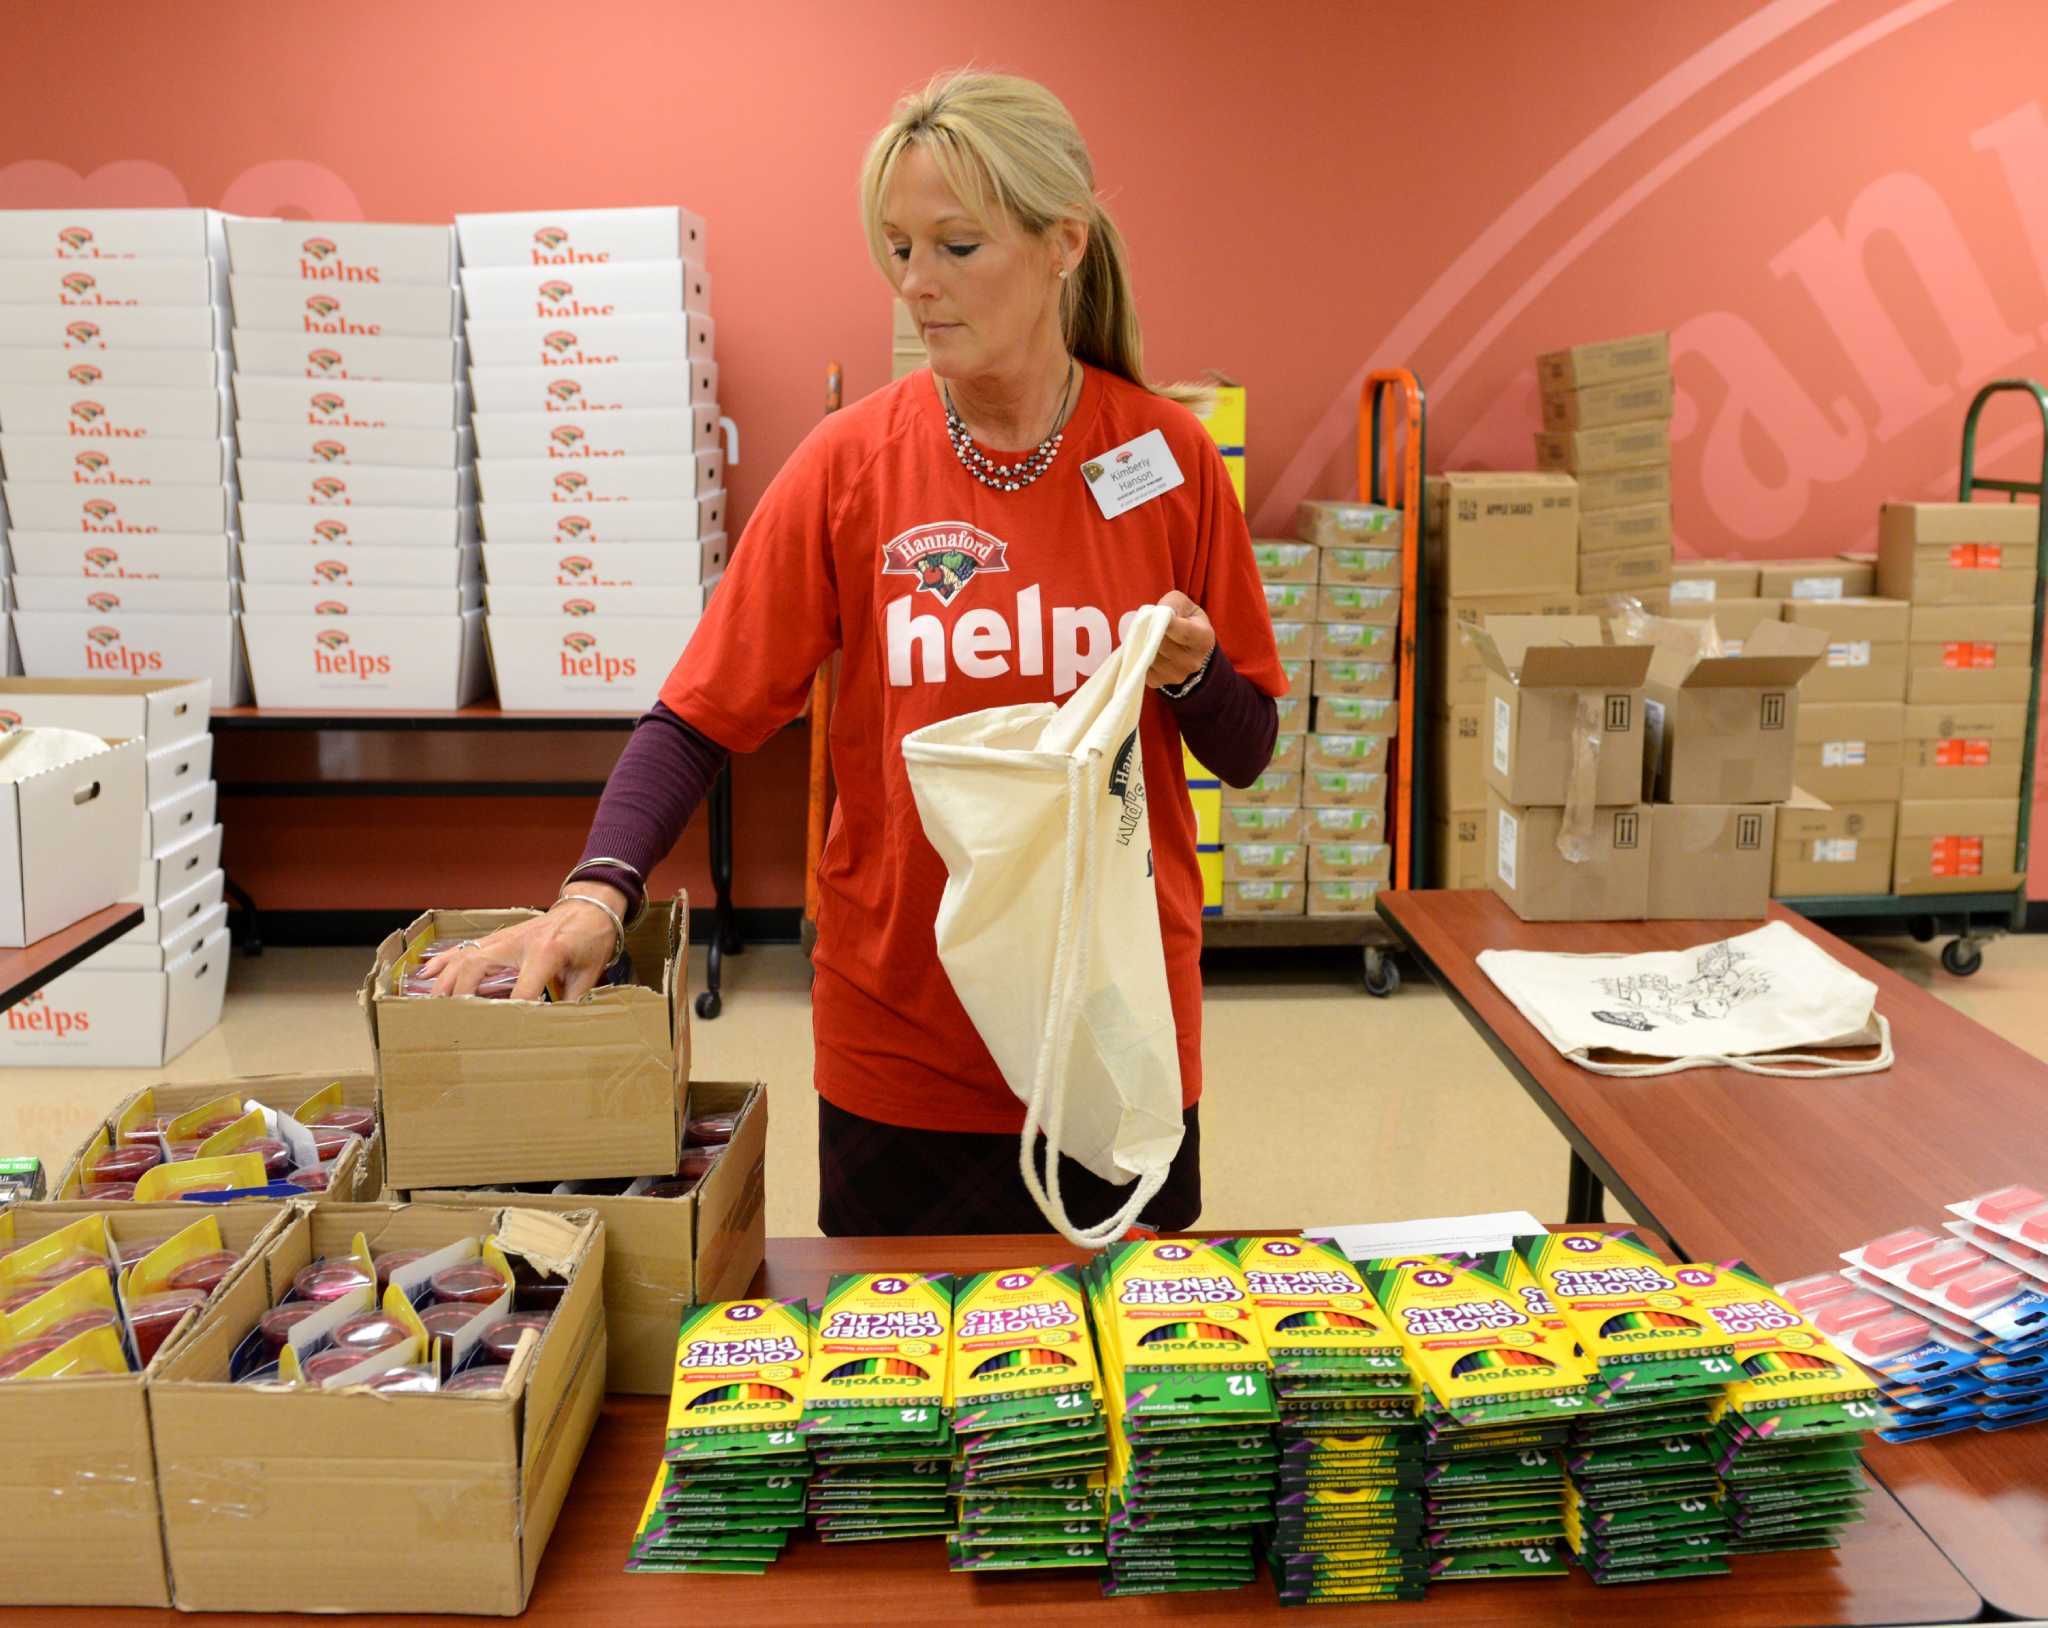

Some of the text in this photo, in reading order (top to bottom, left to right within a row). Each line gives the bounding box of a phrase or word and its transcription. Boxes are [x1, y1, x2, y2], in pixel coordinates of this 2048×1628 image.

[1111, 457, 1151, 482] Kimberly
[1119, 470, 1154, 492] Hanson
[899, 530, 996, 560] Hannaford
[887, 584, 1141, 696] help
[86, 646, 162, 675] helps
[314, 650, 391, 679] helps
[561, 652, 636, 681] helps
[8, 1006, 89, 1037] helps
[1268, 1243, 1295, 1254] 12
[1567, 1240, 1597, 1251] 12
[1160, 1248, 1186, 1258] 12
[1002, 1276, 1028, 1288] 12
[1244, 1271, 1350, 1283] PENCILS
[1419, 1272, 1447, 1284] 12
[1551, 1267, 1665, 1285] PENCILS
[1681, 1271, 1710, 1282] 12
[878, 1281, 902, 1291] 12
[1124, 1277, 1232, 1292] PENCILS
[1247, 1283, 1362, 1294] COLORED
[1555, 1280, 1677, 1297] COLORED
[1120, 1290, 1244, 1304] COLORED
[731, 1307, 757, 1318] 12
[964, 1301, 1070, 1324] PENCILS
[1402, 1300, 1515, 1323] PENCILS
[832, 1312, 936, 1326] PENCILS
[957, 1313, 1078, 1337] COLORED
[1407, 1313, 1529, 1334] COLORED
[821, 1326, 943, 1338] COLORED
[1287, 1328, 1375, 1338] Crayola
[1610, 1329, 1702, 1343] Crayola
[689, 1337, 795, 1355] PENCILS
[1148, 1341, 1242, 1353] Crayola
[680, 1351, 802, 1367] COLORED
[1365, 1358, 1396, 1367] 12
[1700, 1359, 1732, 1373] 12
[978, 1366, 1069, 1382] Crayola
[1463, 1367, 1556, 1382] Crayola
[1752, 1371, 1841, 1386] Crayola
[831, 1377, 921, 1387] Crayola
[1226, 1376, 1256, 1396] 12
[1054, 1394, 1082, 1408] 12
[1550, 1397, 1583, 1407] 12
[695, 1402, 786, 1415] Crayola
[901, 1409, 928, 1422] 12
[1375, 1410, 1404, 1418] 12
[1841, 1402, 1876, 1418] 12
[768, 1432, 796, 1444] 12
[1517, 1451, 1547, 1466] 12
[912, 1463, 938, 1474] 12
[1051, 1478, 1077, 1489] 12
[1065, 1501, 1092, 1511] 12
[1064, 1523, 1091, 1533] 12
[1067, 1544, 1094, 1556] 12
[1519, 1548, 1551, 1563] 12
